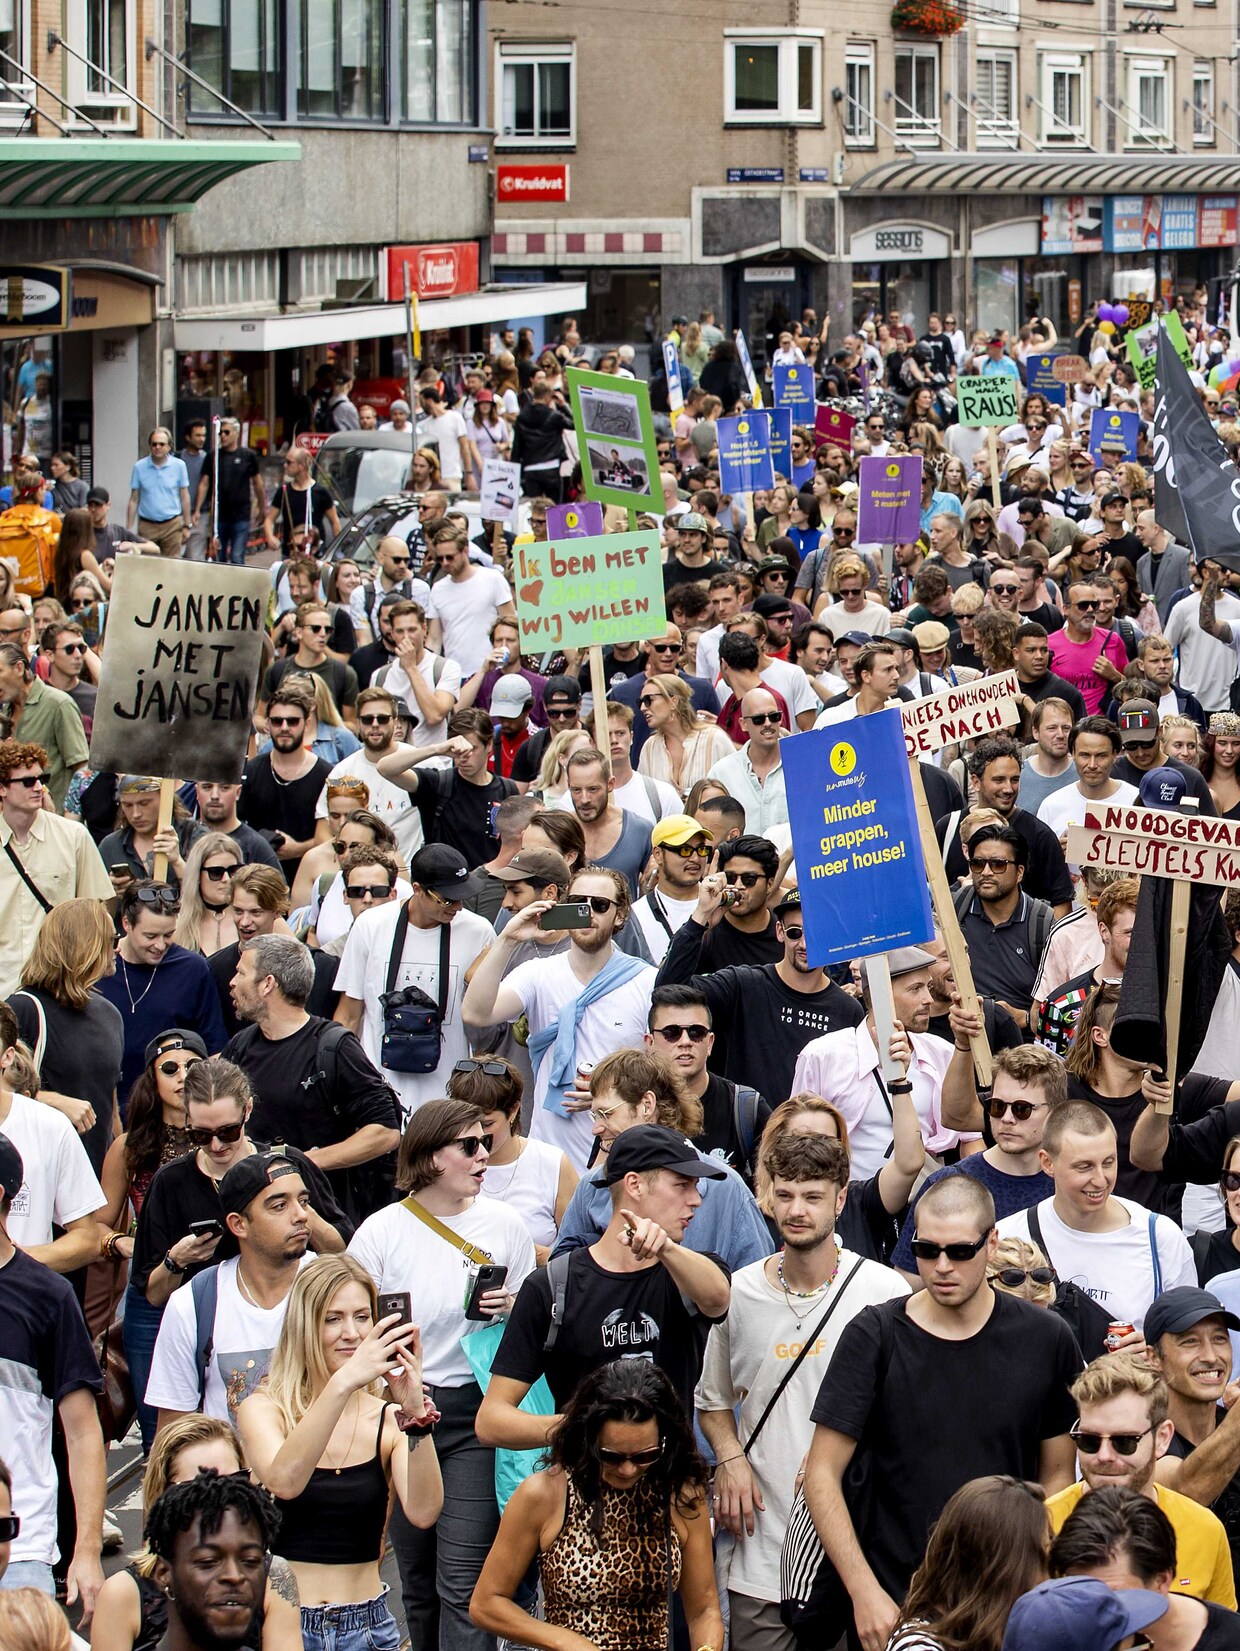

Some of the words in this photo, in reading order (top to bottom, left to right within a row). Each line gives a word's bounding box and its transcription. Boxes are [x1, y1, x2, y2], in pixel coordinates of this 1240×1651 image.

[514, 177, 563, 190] Kruidvat
[964, 394, 1018, 420] RAUS!
[871, 490, 896, 499] Meten
[605, 546, 650, 569] MET
[568, 597, 650, 625] WILLEN
[153, 638, 235, 679] MET
[940, 707, 1002, 745] NACH
[823, 799, 877, 825] Minder
[820, 823, 889, 856] grappen,
[810, 859, 849, 880] meer
[853, 841, 906, 870] house!
[1087, 834, 1209, 879] SLEUTELS
[781, 1015, 793, 1023] TO
[798, 1019, 828, 1032] DANCE
[782, 1006, 793, 1014] IN
[798, 1010, 830, 1023] ORDER
[602, 1319, 651, 1347] WELT
